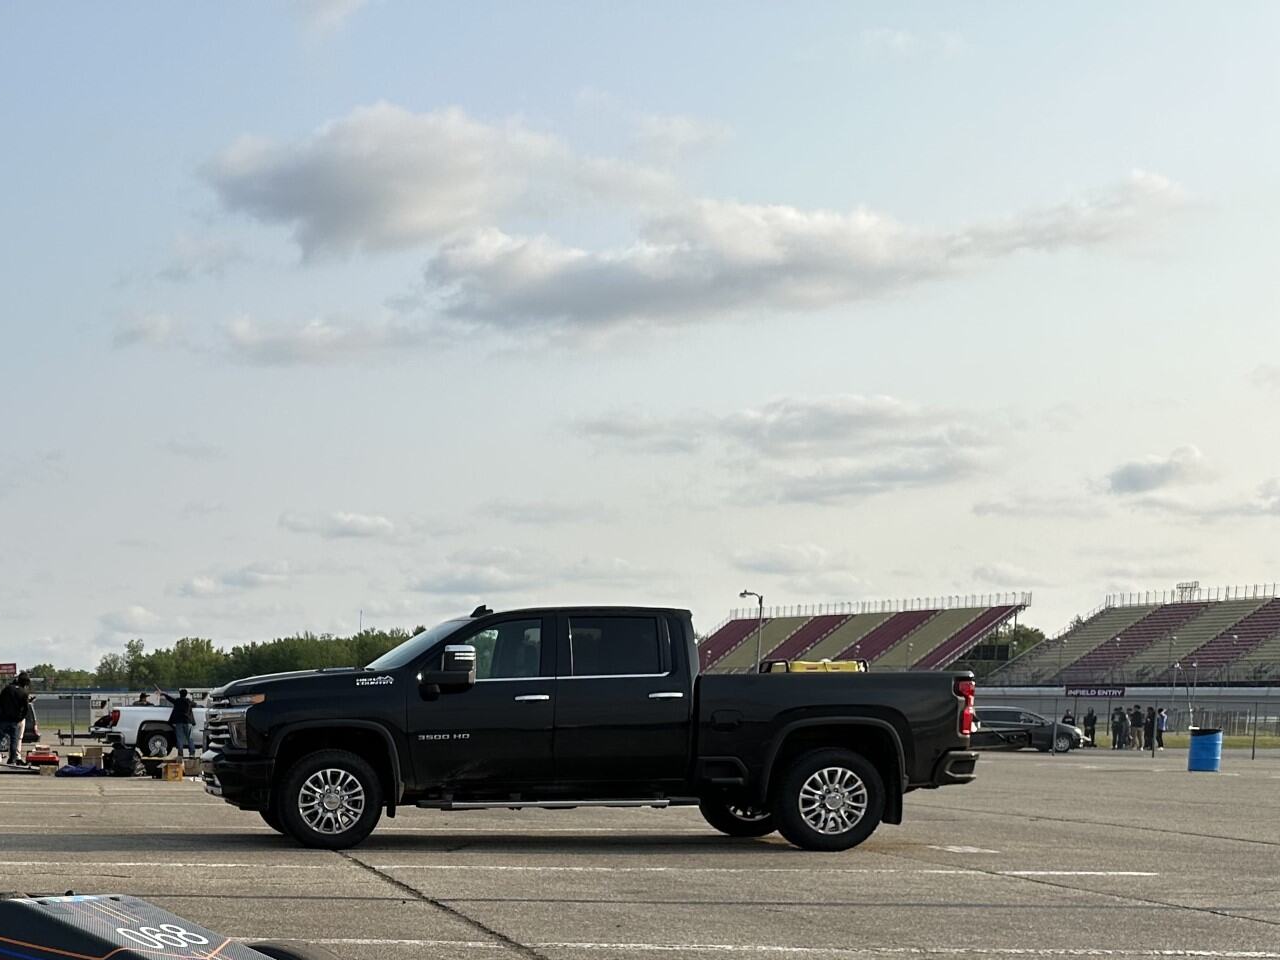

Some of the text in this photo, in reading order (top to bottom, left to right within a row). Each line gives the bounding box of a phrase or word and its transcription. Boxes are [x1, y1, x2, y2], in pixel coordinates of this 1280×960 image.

[1067, 689, 1123, 697] INFIELD ENTRY
[116, 923, 209, 950] 068
